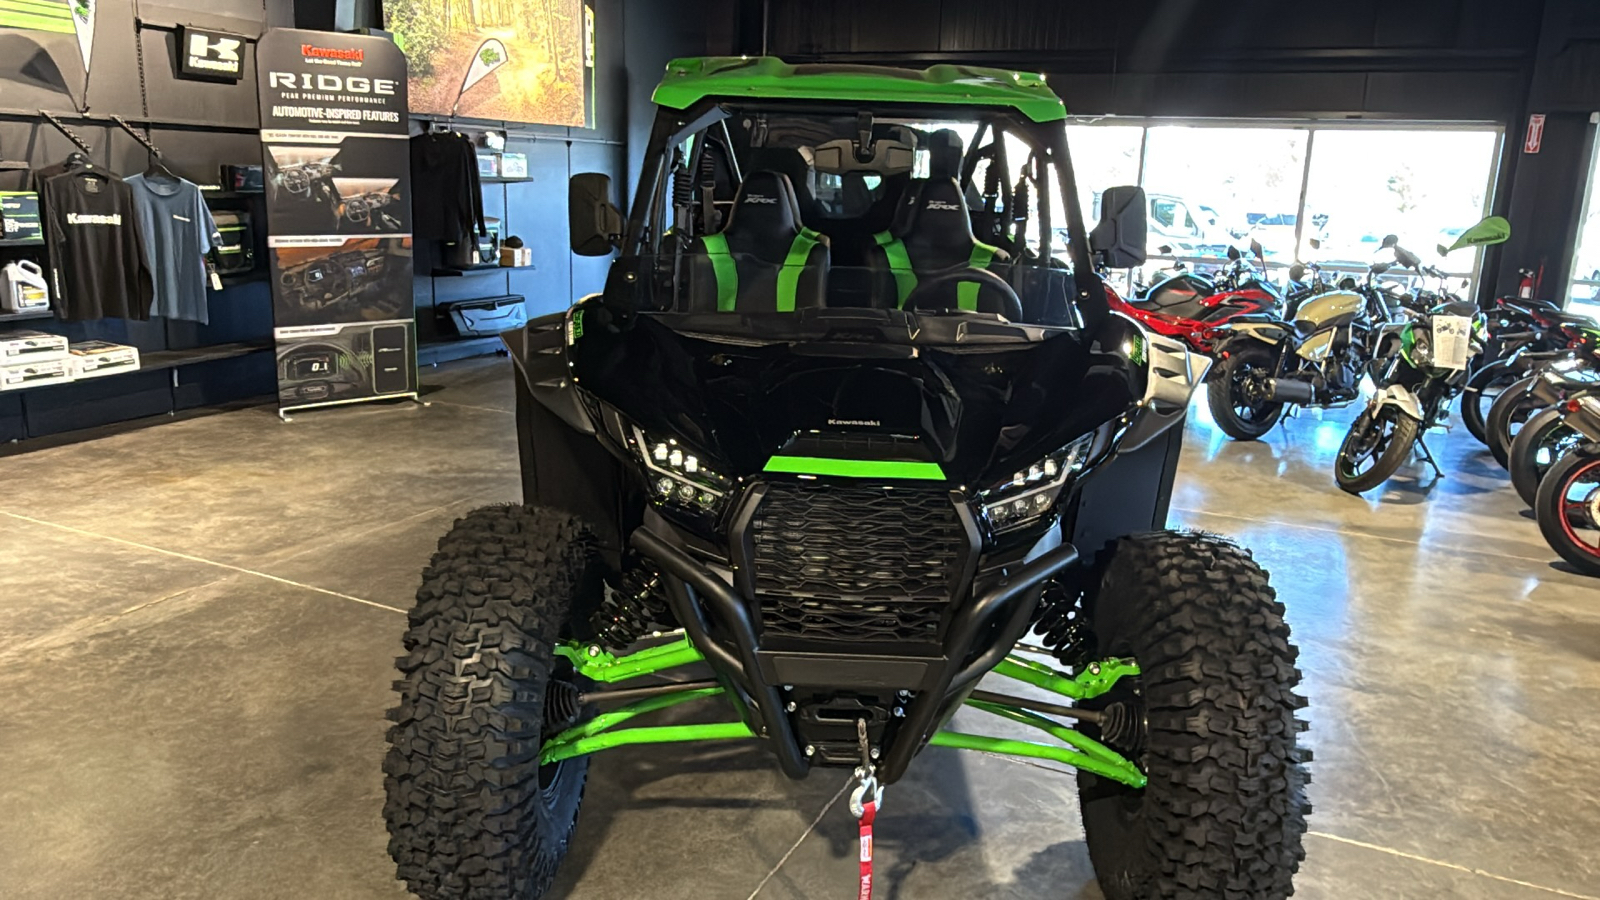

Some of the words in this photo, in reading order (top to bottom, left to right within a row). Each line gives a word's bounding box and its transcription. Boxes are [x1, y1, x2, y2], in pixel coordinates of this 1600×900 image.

[301, 44, 364, 61] Kawasaki
[189, 55, 238, 72] Kawasaki
[269, 71, 395, 95] RIDGE
[302, 93, 336, 102] PREMIUM
[337, 95, 387, 105] PERFORMANCE
[272, 105, 362, 120] AUTOMOTIVE-INSPIRED
[362, 110, 400, 123] FEATURES
[66, 212, 122, 226] Kawasaki
[827, 418, 881, 427] Kawasaki
